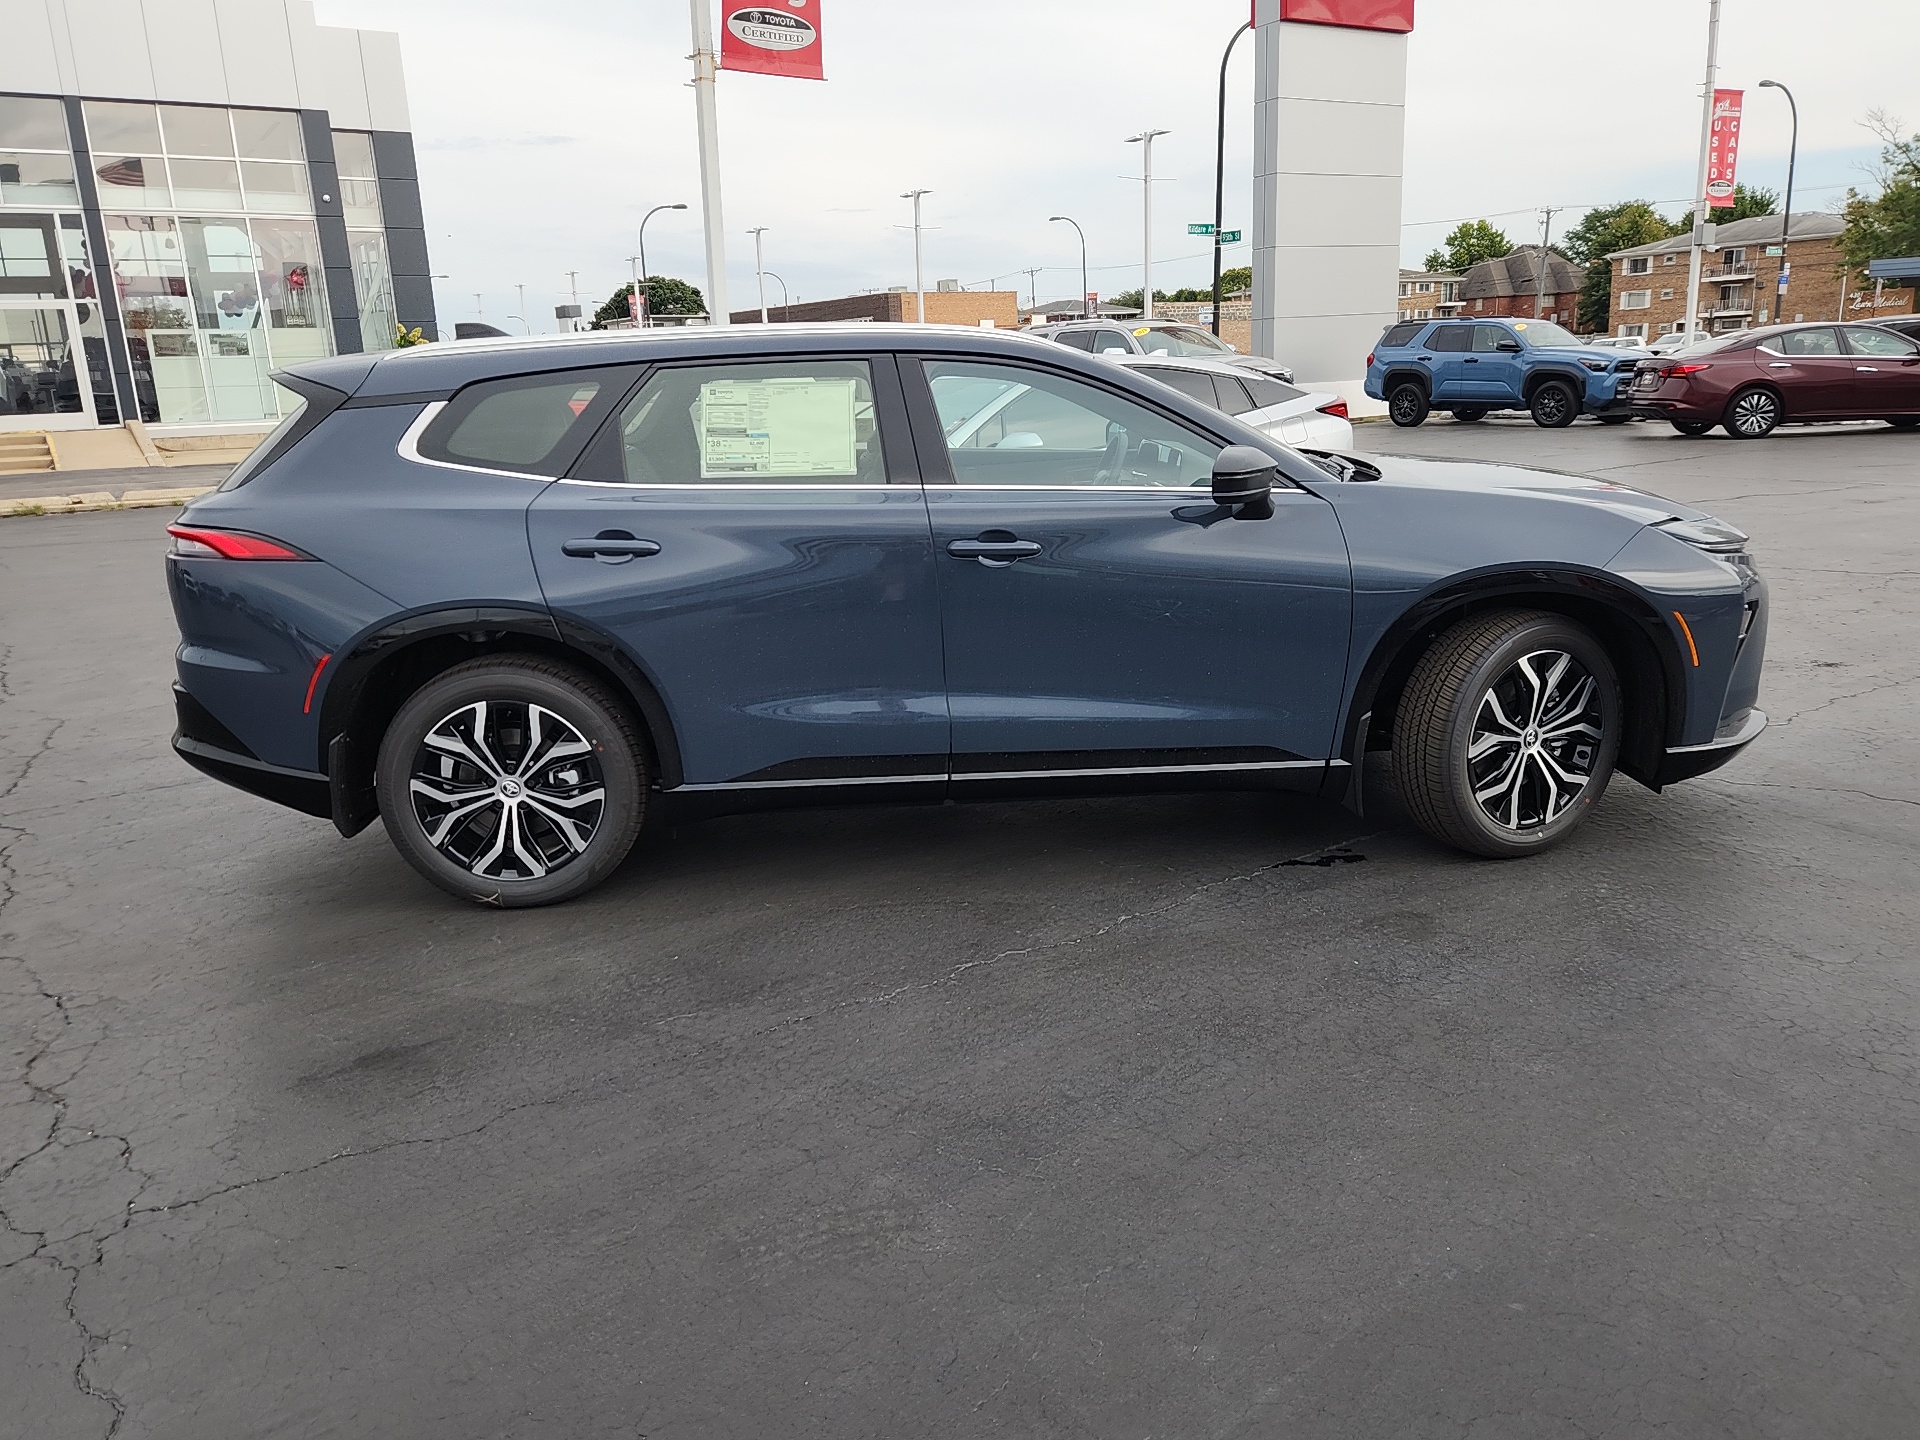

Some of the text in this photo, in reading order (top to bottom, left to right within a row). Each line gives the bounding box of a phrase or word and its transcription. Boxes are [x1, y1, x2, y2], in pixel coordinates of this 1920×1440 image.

[764, 15, 796, 27] TOYOTA
[742, 25, 804, 43] CERTIFIED
[1710, 120, 1721, 179] USED
[1725, 121, 1738, 179] CARS
[1188, 225, 1206, 233] Kildare
[1222, 233, 1233, 241] 95th
[1848, 296, 1873, 311] Lawn
